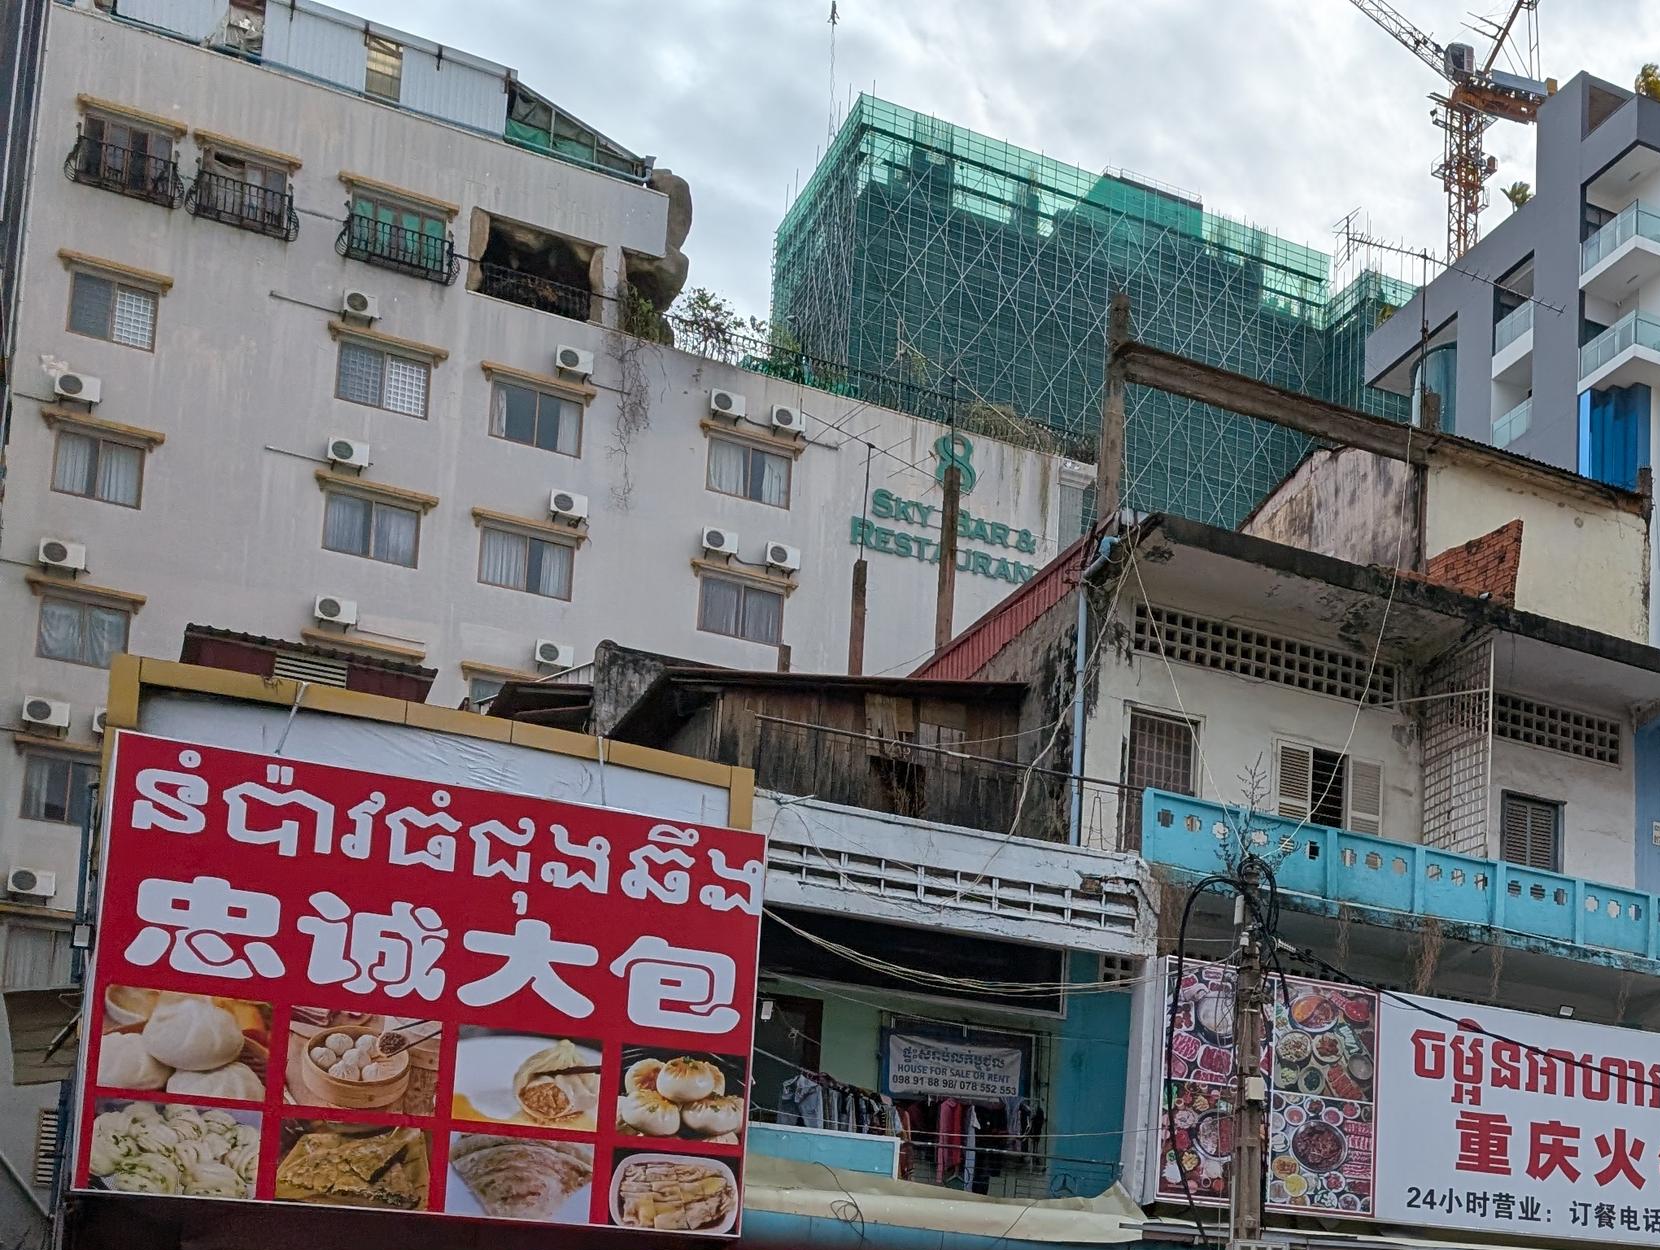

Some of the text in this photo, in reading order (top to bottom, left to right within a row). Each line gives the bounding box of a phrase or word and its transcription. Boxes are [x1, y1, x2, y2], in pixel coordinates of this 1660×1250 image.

[871, 487, 1037, 555] SKY BAR &
[124, 876, 742, 1035] 忠诚大包
[892, 1074, 910, 1085] 098
[913, 1076, 924, 1086] 91
[927, 1077, 939, 1088] 88
[959, 1080, 977, 1091] 078
[980, 1083, 998, 1094] 552
[1000, 1085, 1017, 1096] 553
[897, 1063, 1011, 1084] HOUSE FOR SALE OR RENT
